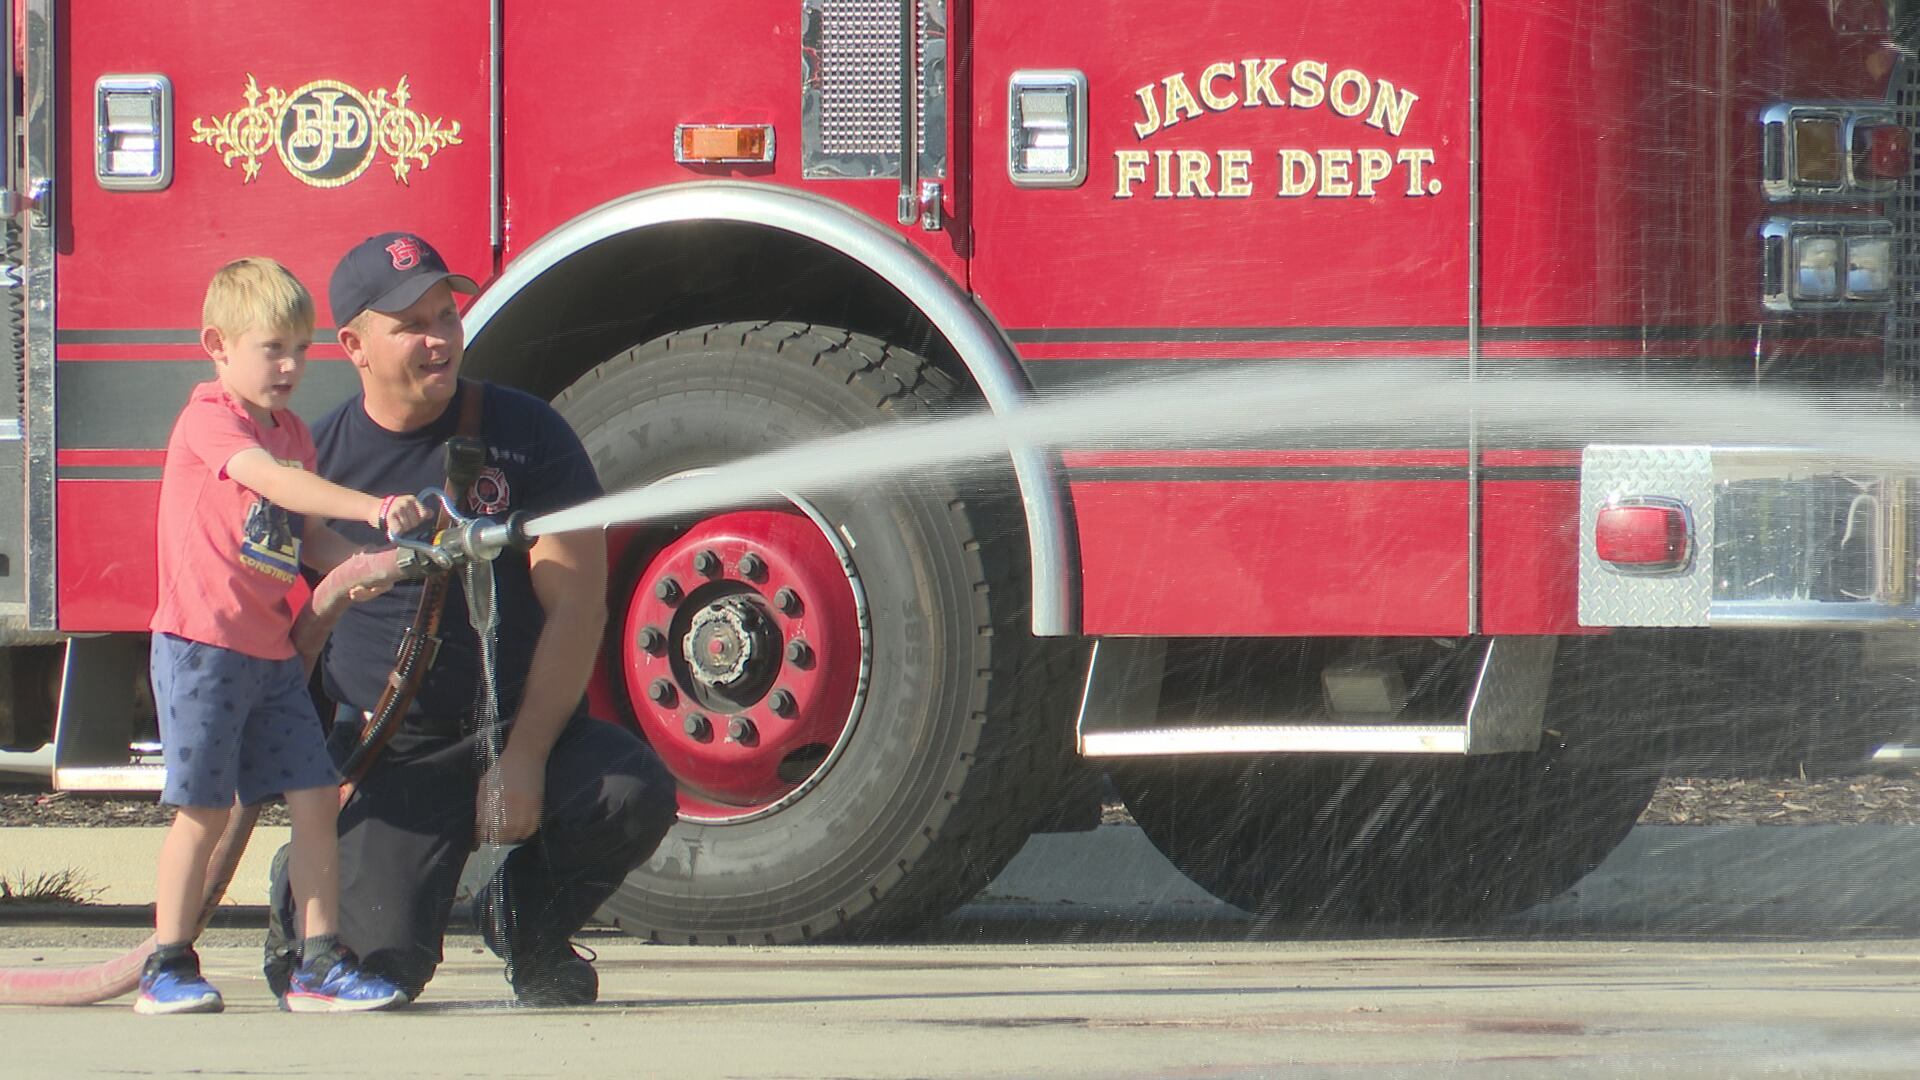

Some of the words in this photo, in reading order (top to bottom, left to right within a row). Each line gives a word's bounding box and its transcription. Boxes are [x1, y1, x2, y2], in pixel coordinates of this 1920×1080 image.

[1134, 58, 1419, 139] JACKSON
[1113, 149, 1253, 198] FIRE
[1278, 149, 1443, 197] DEPT.
